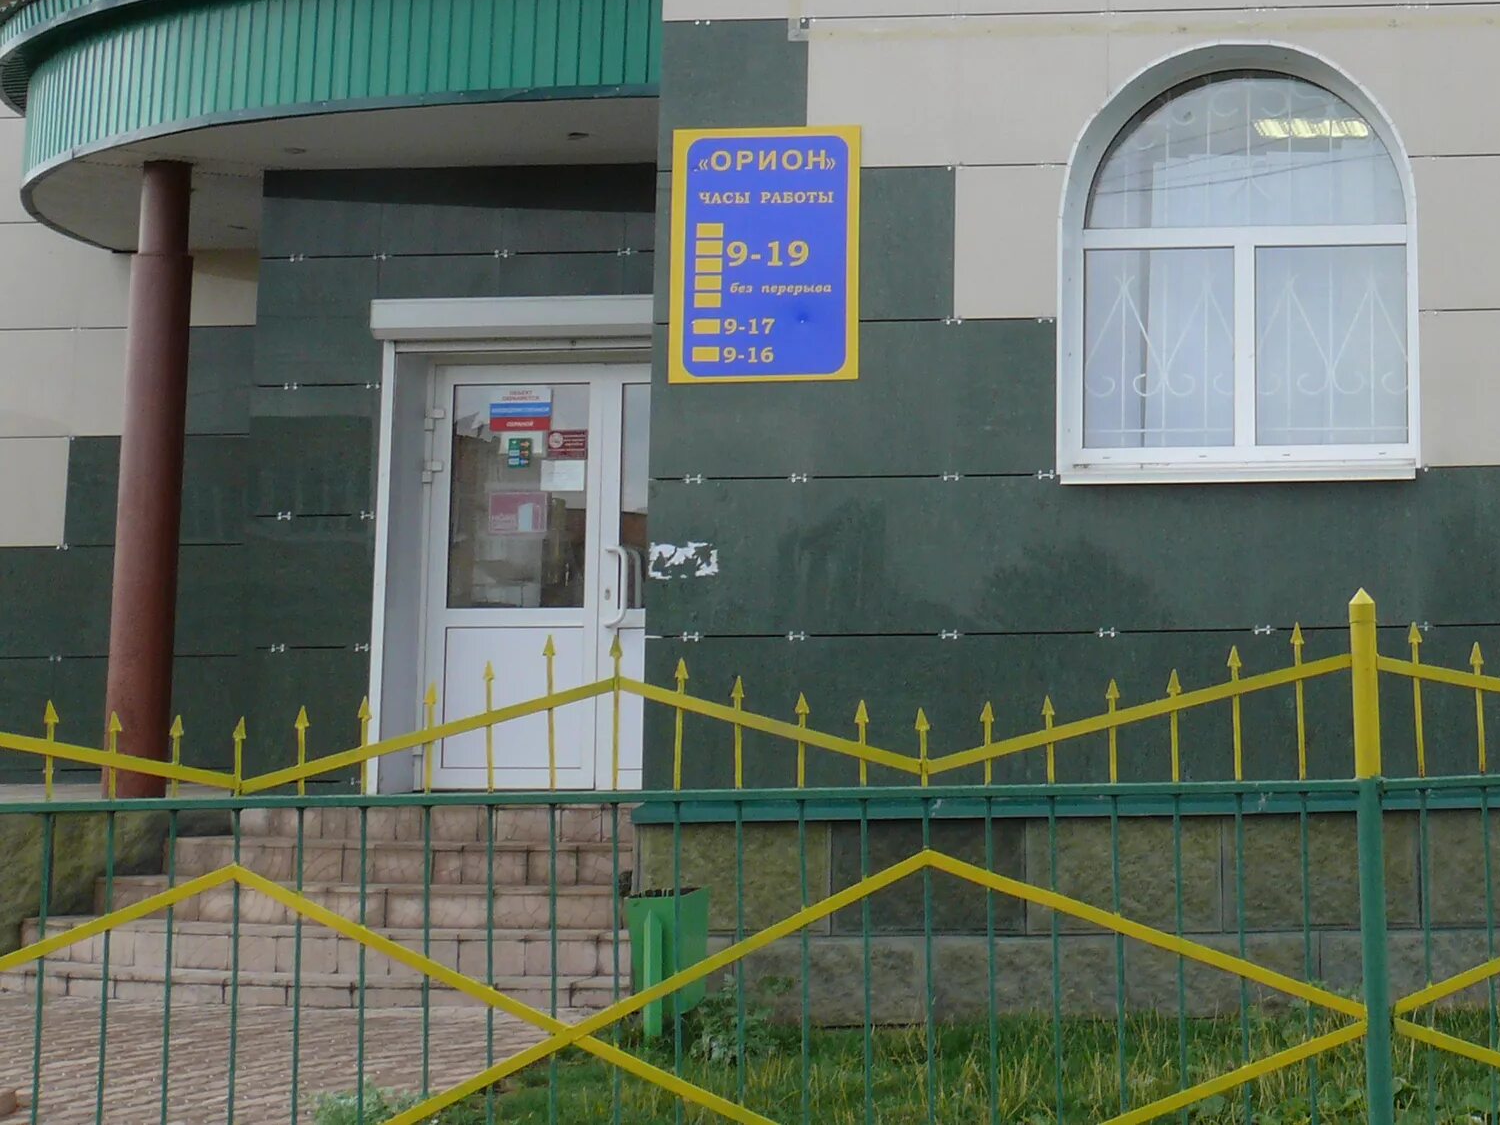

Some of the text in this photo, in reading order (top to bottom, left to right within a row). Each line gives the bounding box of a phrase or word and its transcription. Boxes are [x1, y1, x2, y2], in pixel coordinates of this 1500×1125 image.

[699, 149, 836, 171] «ОРИОН»
[699, 191, 834, 204] ЧАСЫ РАБОТЫ
[727, 241, 809, 267] 9-19
[730, 282, 832, 295] без перерыва
[724, 319, 775, 334] 9-17
[723, 347, 774, 363] 9-16
